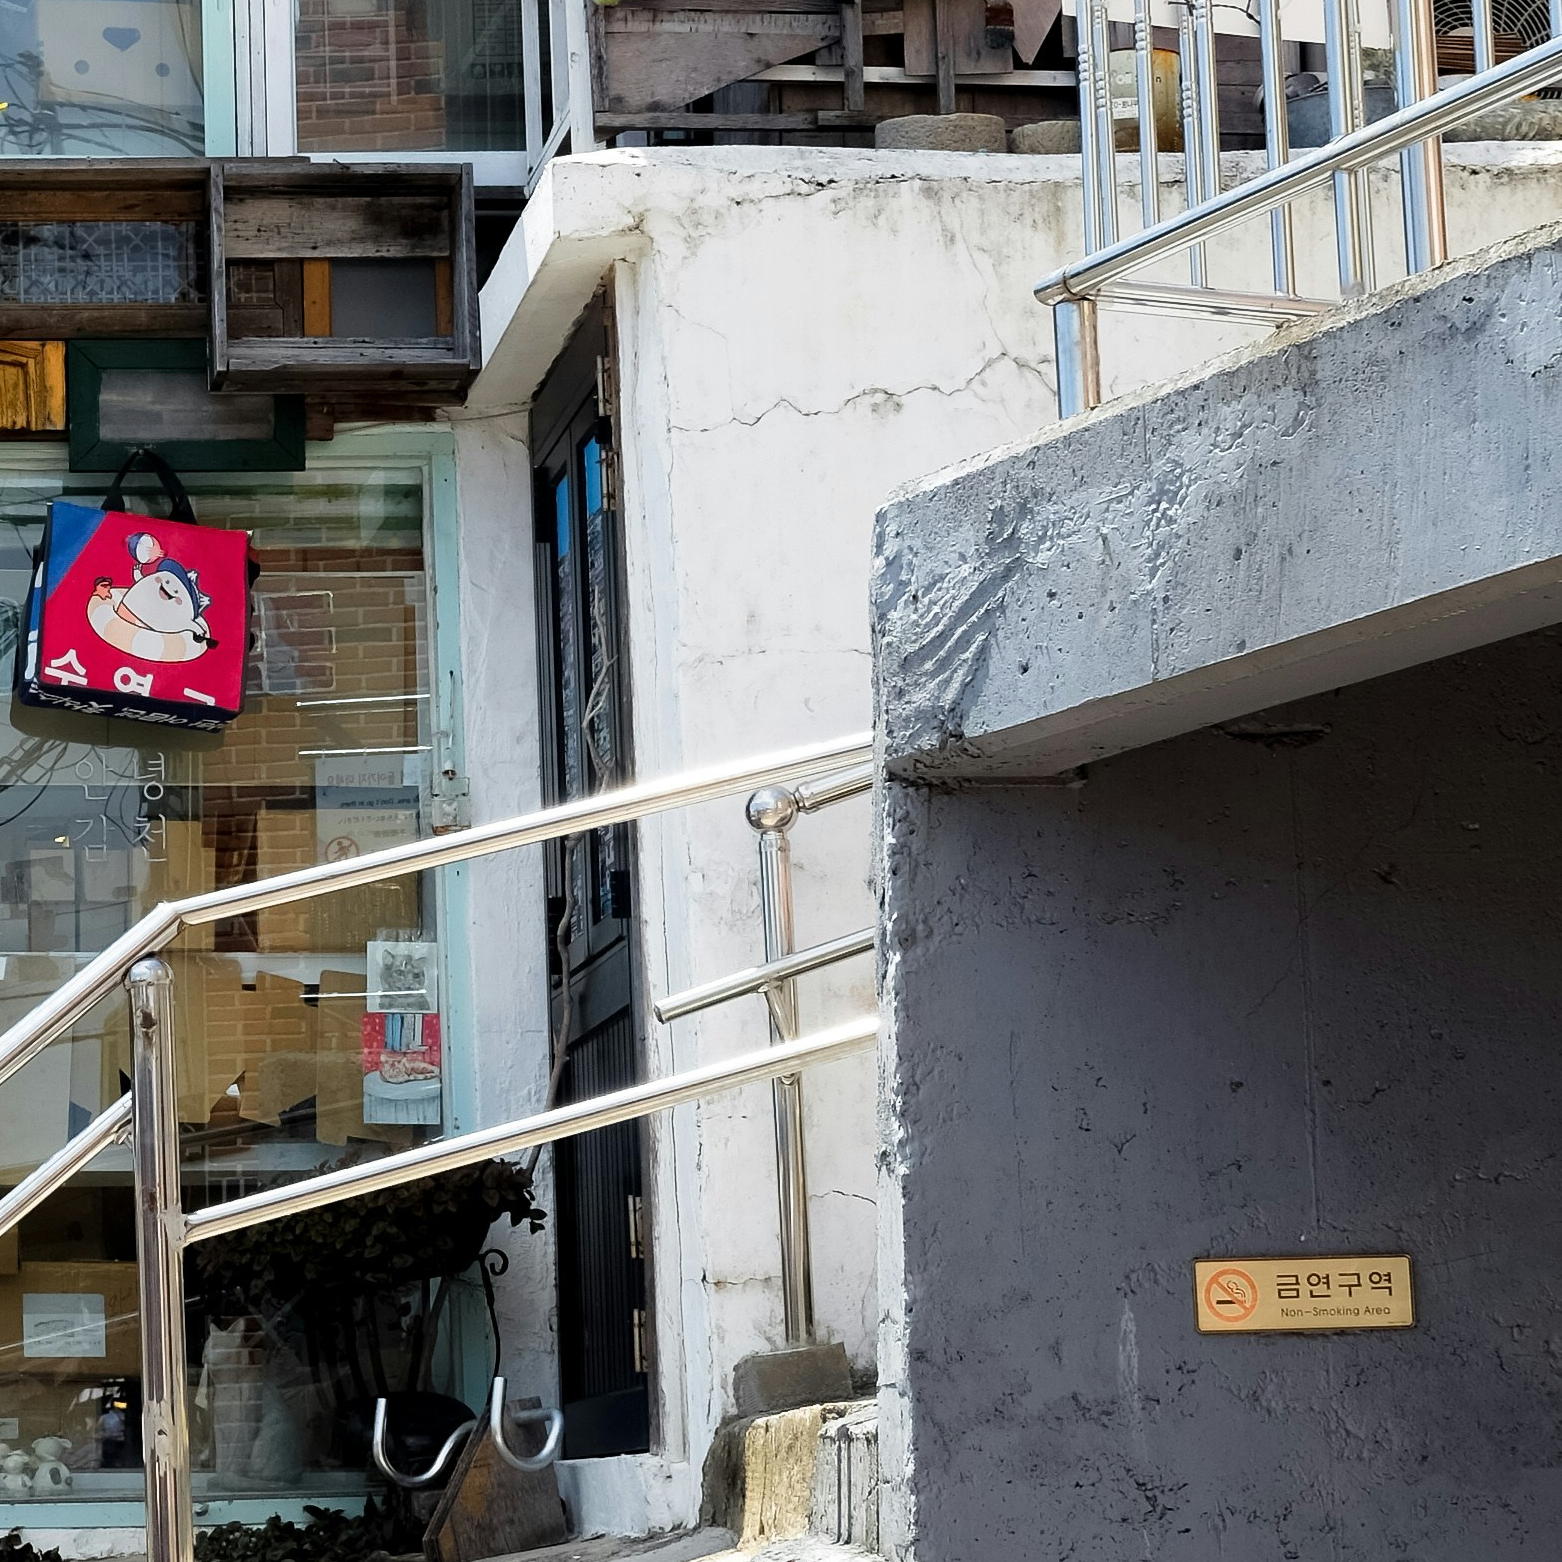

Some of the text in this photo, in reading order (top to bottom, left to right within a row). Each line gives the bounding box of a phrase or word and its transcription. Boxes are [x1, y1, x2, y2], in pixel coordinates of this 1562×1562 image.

[74, 751, 166, 801] 안녕
[72, 813, 168, 862] 감천
[1275, 1270, 1393, 1300] 금연구역
[1280, 1305, 1391, 1319] Non-Smoking Area
